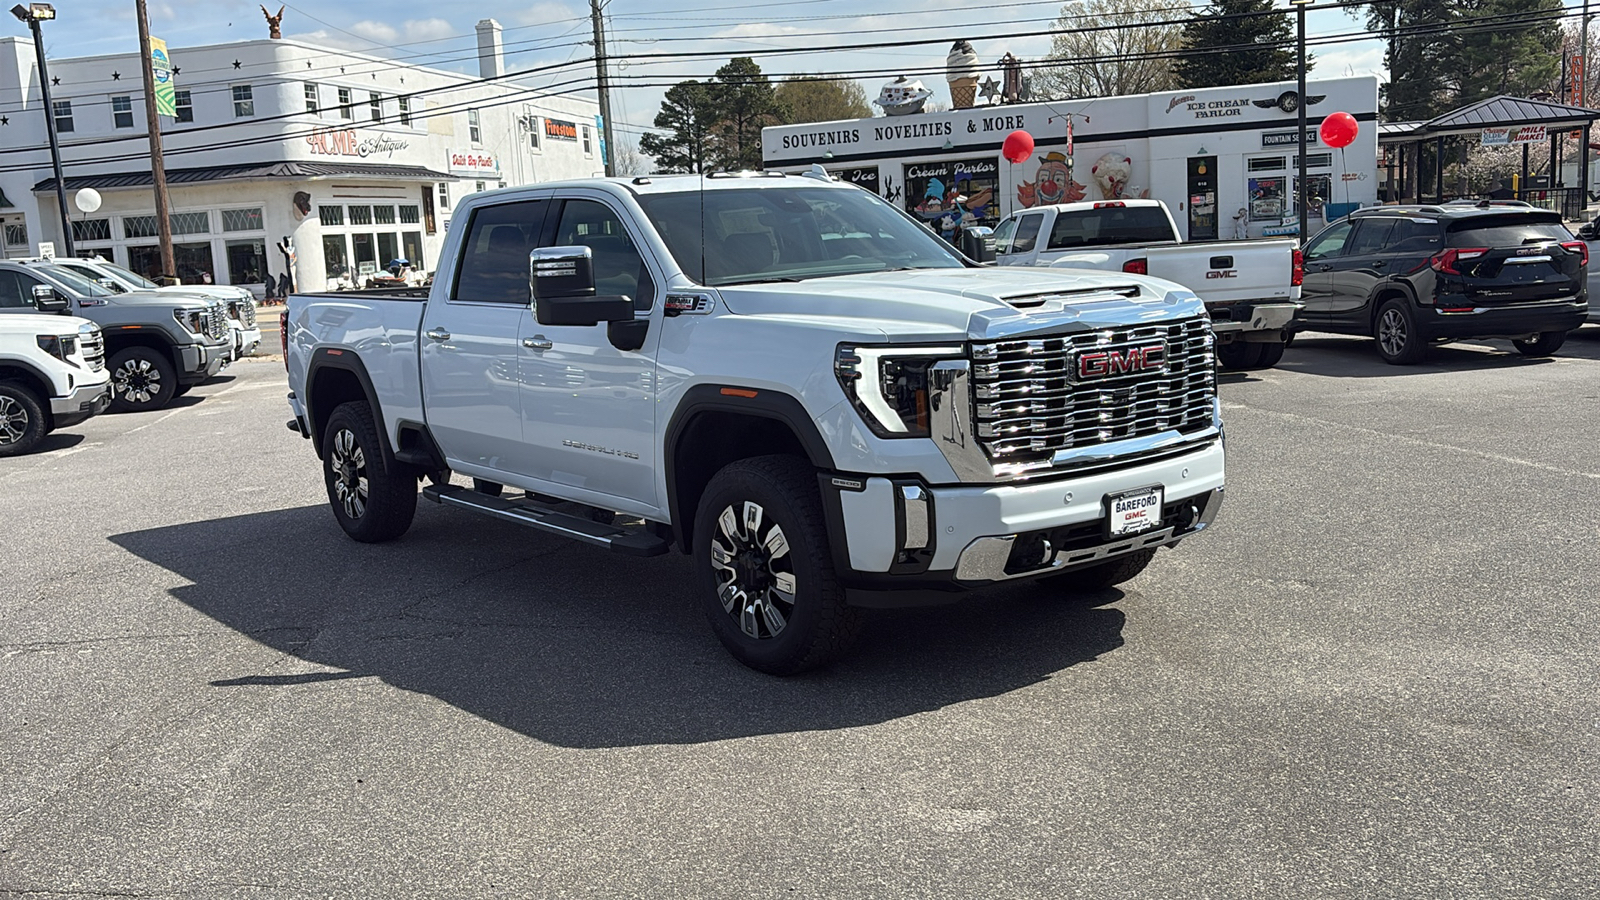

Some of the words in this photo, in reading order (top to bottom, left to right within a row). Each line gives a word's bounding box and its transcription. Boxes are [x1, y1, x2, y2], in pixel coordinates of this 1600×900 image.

[1187, 102, 1206, 111] ICE
[1208, 99, 1250, 109] CREAM
[1195, 108, 1241, 119] PARLOR
[545, 118, 577, 138] Firestone
[782, 129, 860, 149] SOUVENIRS
[874, 121, 952, 141] NOVELTIES
[967, 119, 977, 133] &
[983, 115, 1024, 132] MORE
[1520, 126, 1546, 134] MILK
[306, 126, 358, 156] ACME
[358, 133, 410, 159] Antiques
[1264, 134, 1292, 144] FOUNTAIN
[1292, 132, 1315, 142] SEICE
[1514, 133, 1545, 142] SHAKES
[452, 154, 466, 166] Dutch
[467, 155, 477, 169] Boy
[478, 155, 493, 167] Paints
[851, 169, 877, 182] Ice
[908, 166, 948, 178] Cream
[953, 162, 996, 175] Parlor
[1206, 270, 1238, 279] GMC
[1078, 346, 1165, 378] GMC
[1115, 496, 1157, 513] BAREFORD
[1125, 509, 1147, 520] GMC
